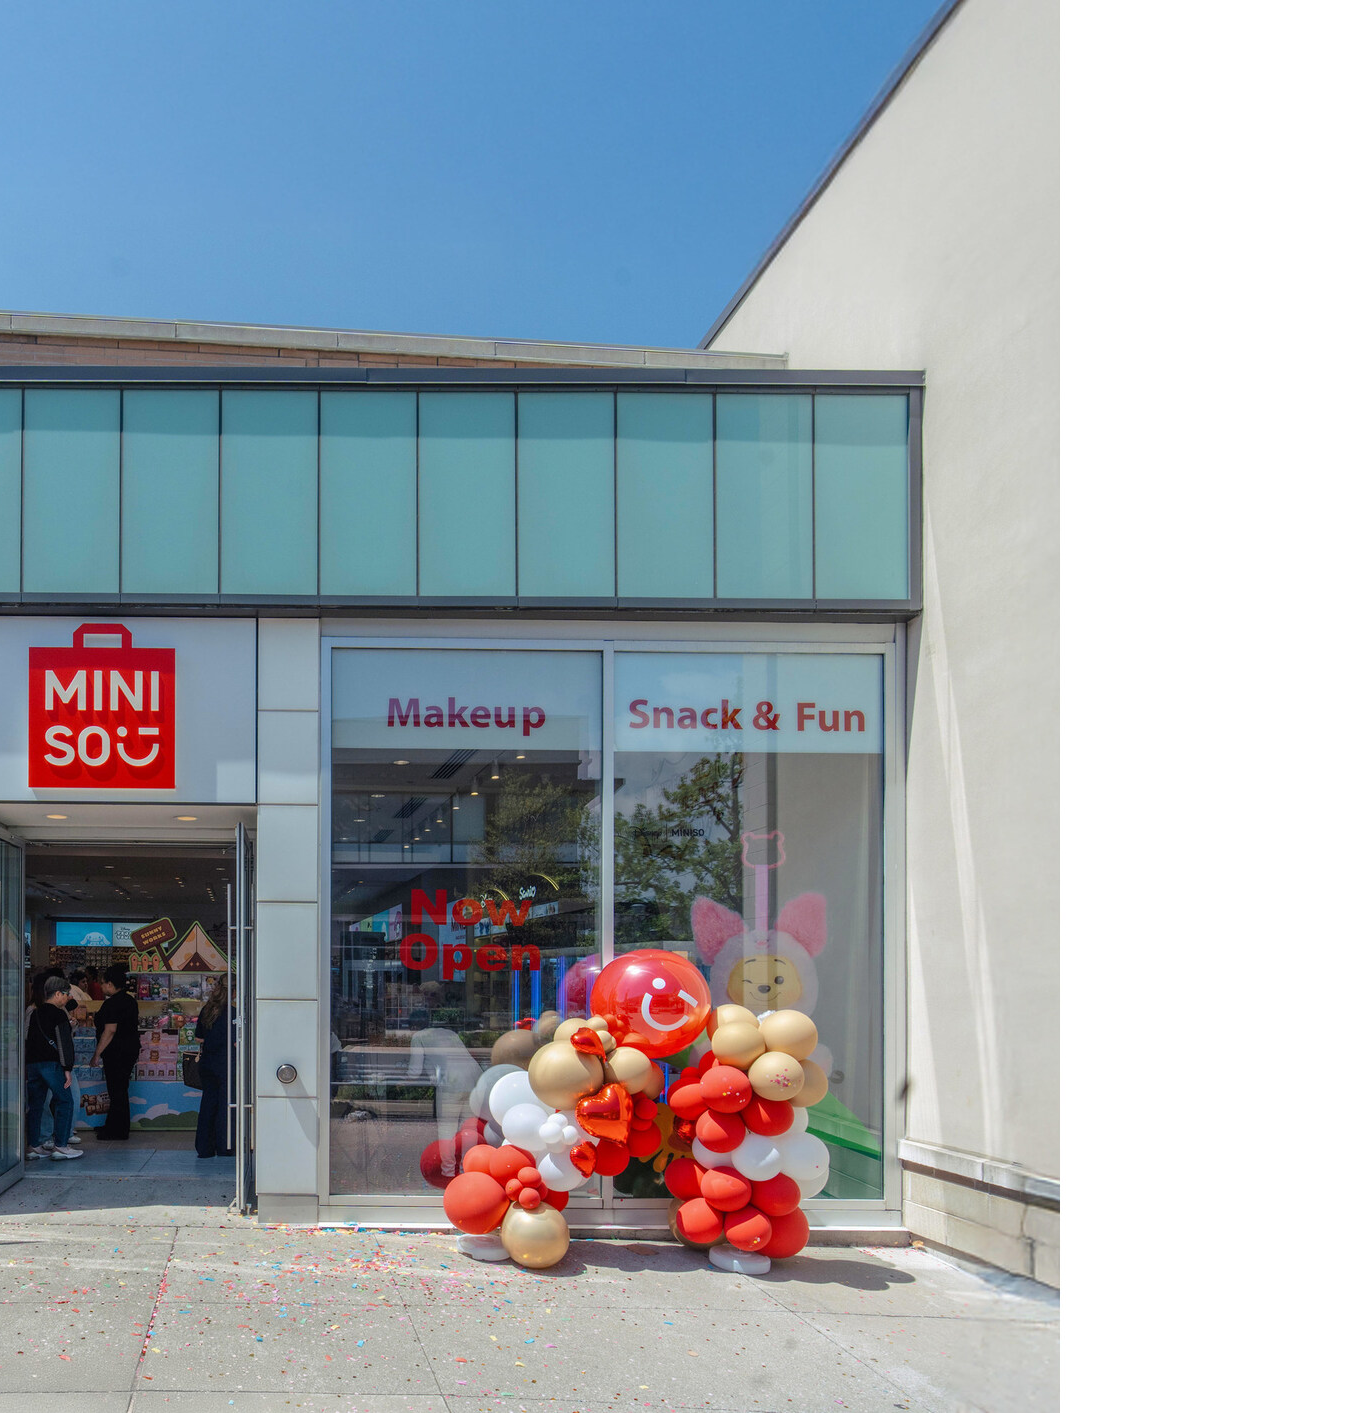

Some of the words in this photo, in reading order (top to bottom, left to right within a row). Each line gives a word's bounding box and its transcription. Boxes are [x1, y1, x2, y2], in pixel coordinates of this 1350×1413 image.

[44, 669, 160, 712] MINI
[387, 696, 546, 737] Makeup
[628, 698, 743, 731] Snack
[752, 700, 781, 731] &
[796, 702, 866, 733] Fun
[671, 828, 705, 837] MINISO
[410, 888, 532, 927] Now
[141, 925, 163, 939] SUNNY
[142, 931, 166, 946] WORKS
[399, 933, 541, 981] Open
